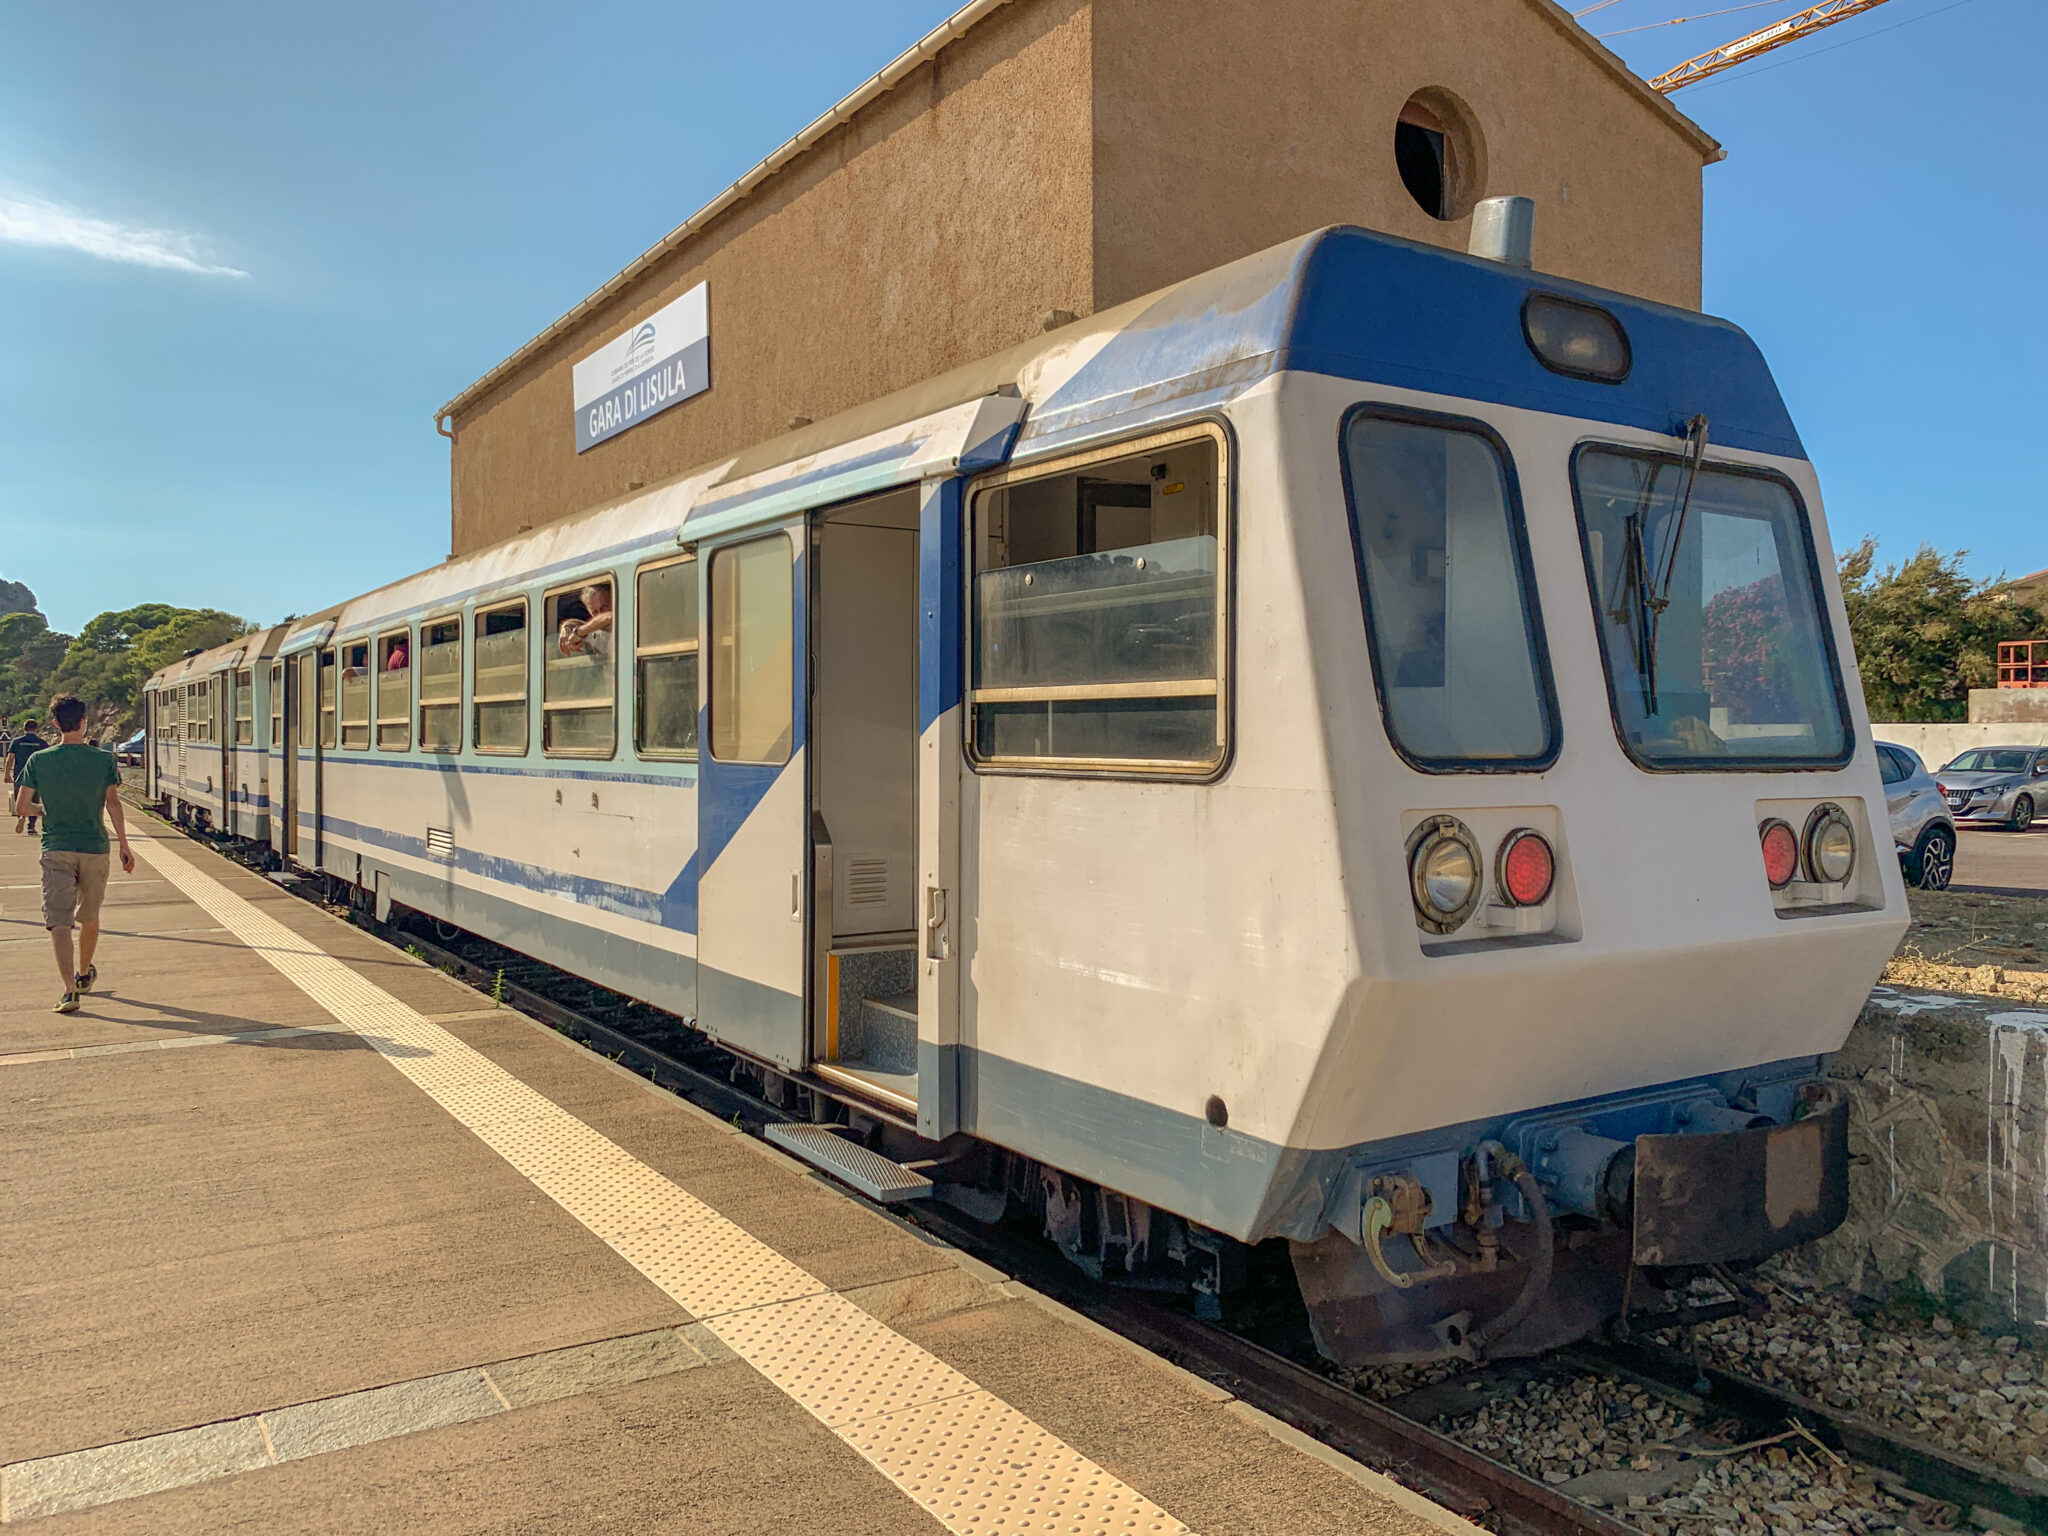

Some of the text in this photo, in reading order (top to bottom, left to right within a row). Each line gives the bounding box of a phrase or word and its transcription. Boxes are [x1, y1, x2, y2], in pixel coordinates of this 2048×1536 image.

[589, 396, 622, 438] GARA
[624, 385, 637, 421] DI
[640, 359, 686, 412] LISULA
